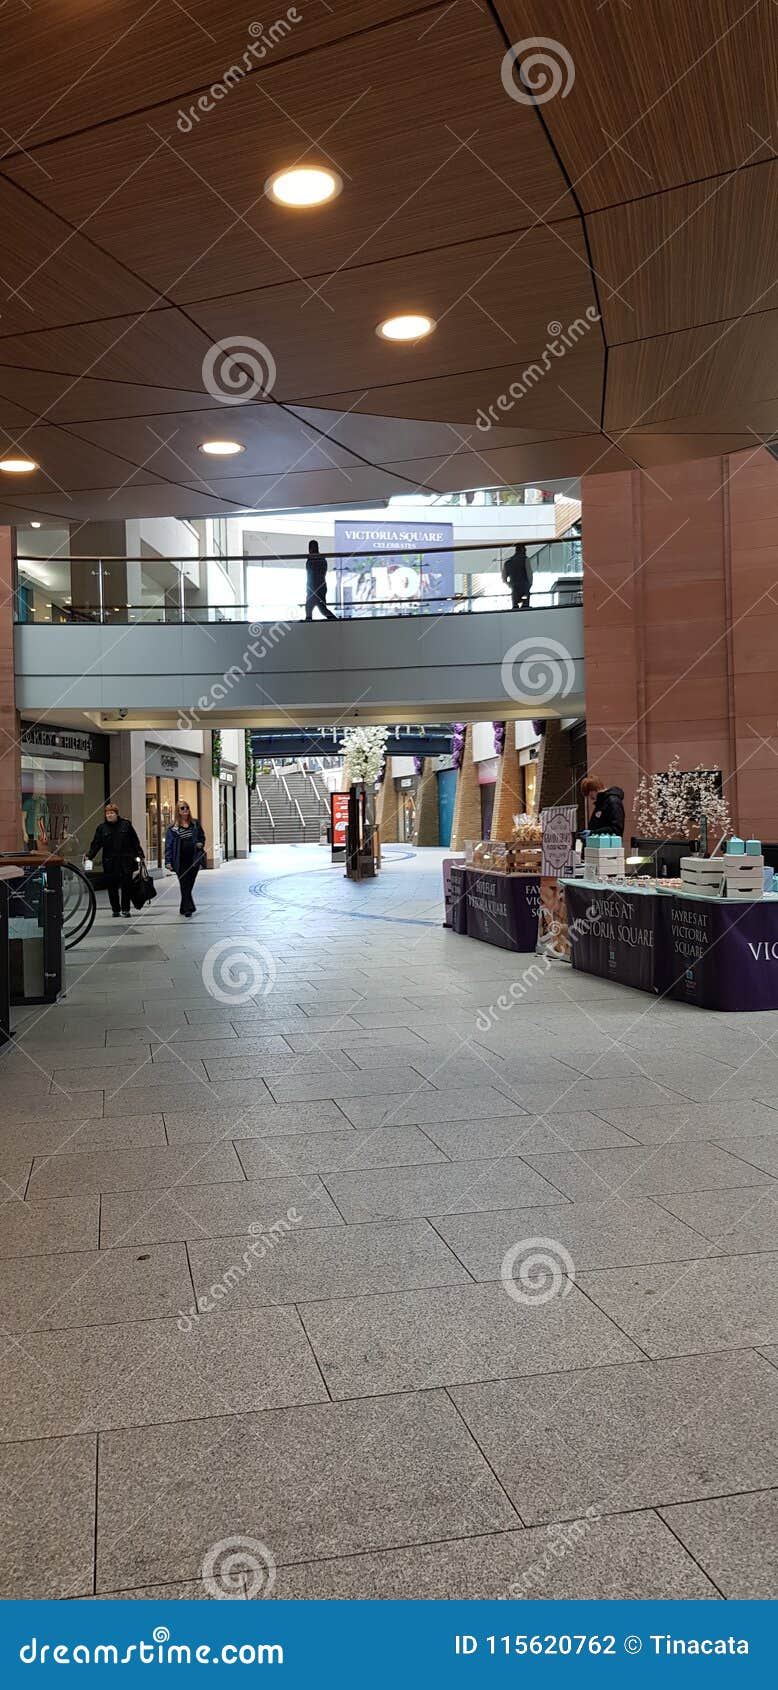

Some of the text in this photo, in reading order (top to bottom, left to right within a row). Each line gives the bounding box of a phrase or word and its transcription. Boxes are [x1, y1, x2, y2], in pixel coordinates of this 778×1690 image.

[345, 530, 444, 542] VICTORIA SQUARE
[371, 566, 421, 598] 10
[591, 898, 633, 920] FAYRES AT
[671, 908, 709, 927] FAYRES AT
[617, 924, 654, 948] SQUARE
[671, 925, 709, 943] VICTORIA
[674, 941, 704, 958] SQUARE
